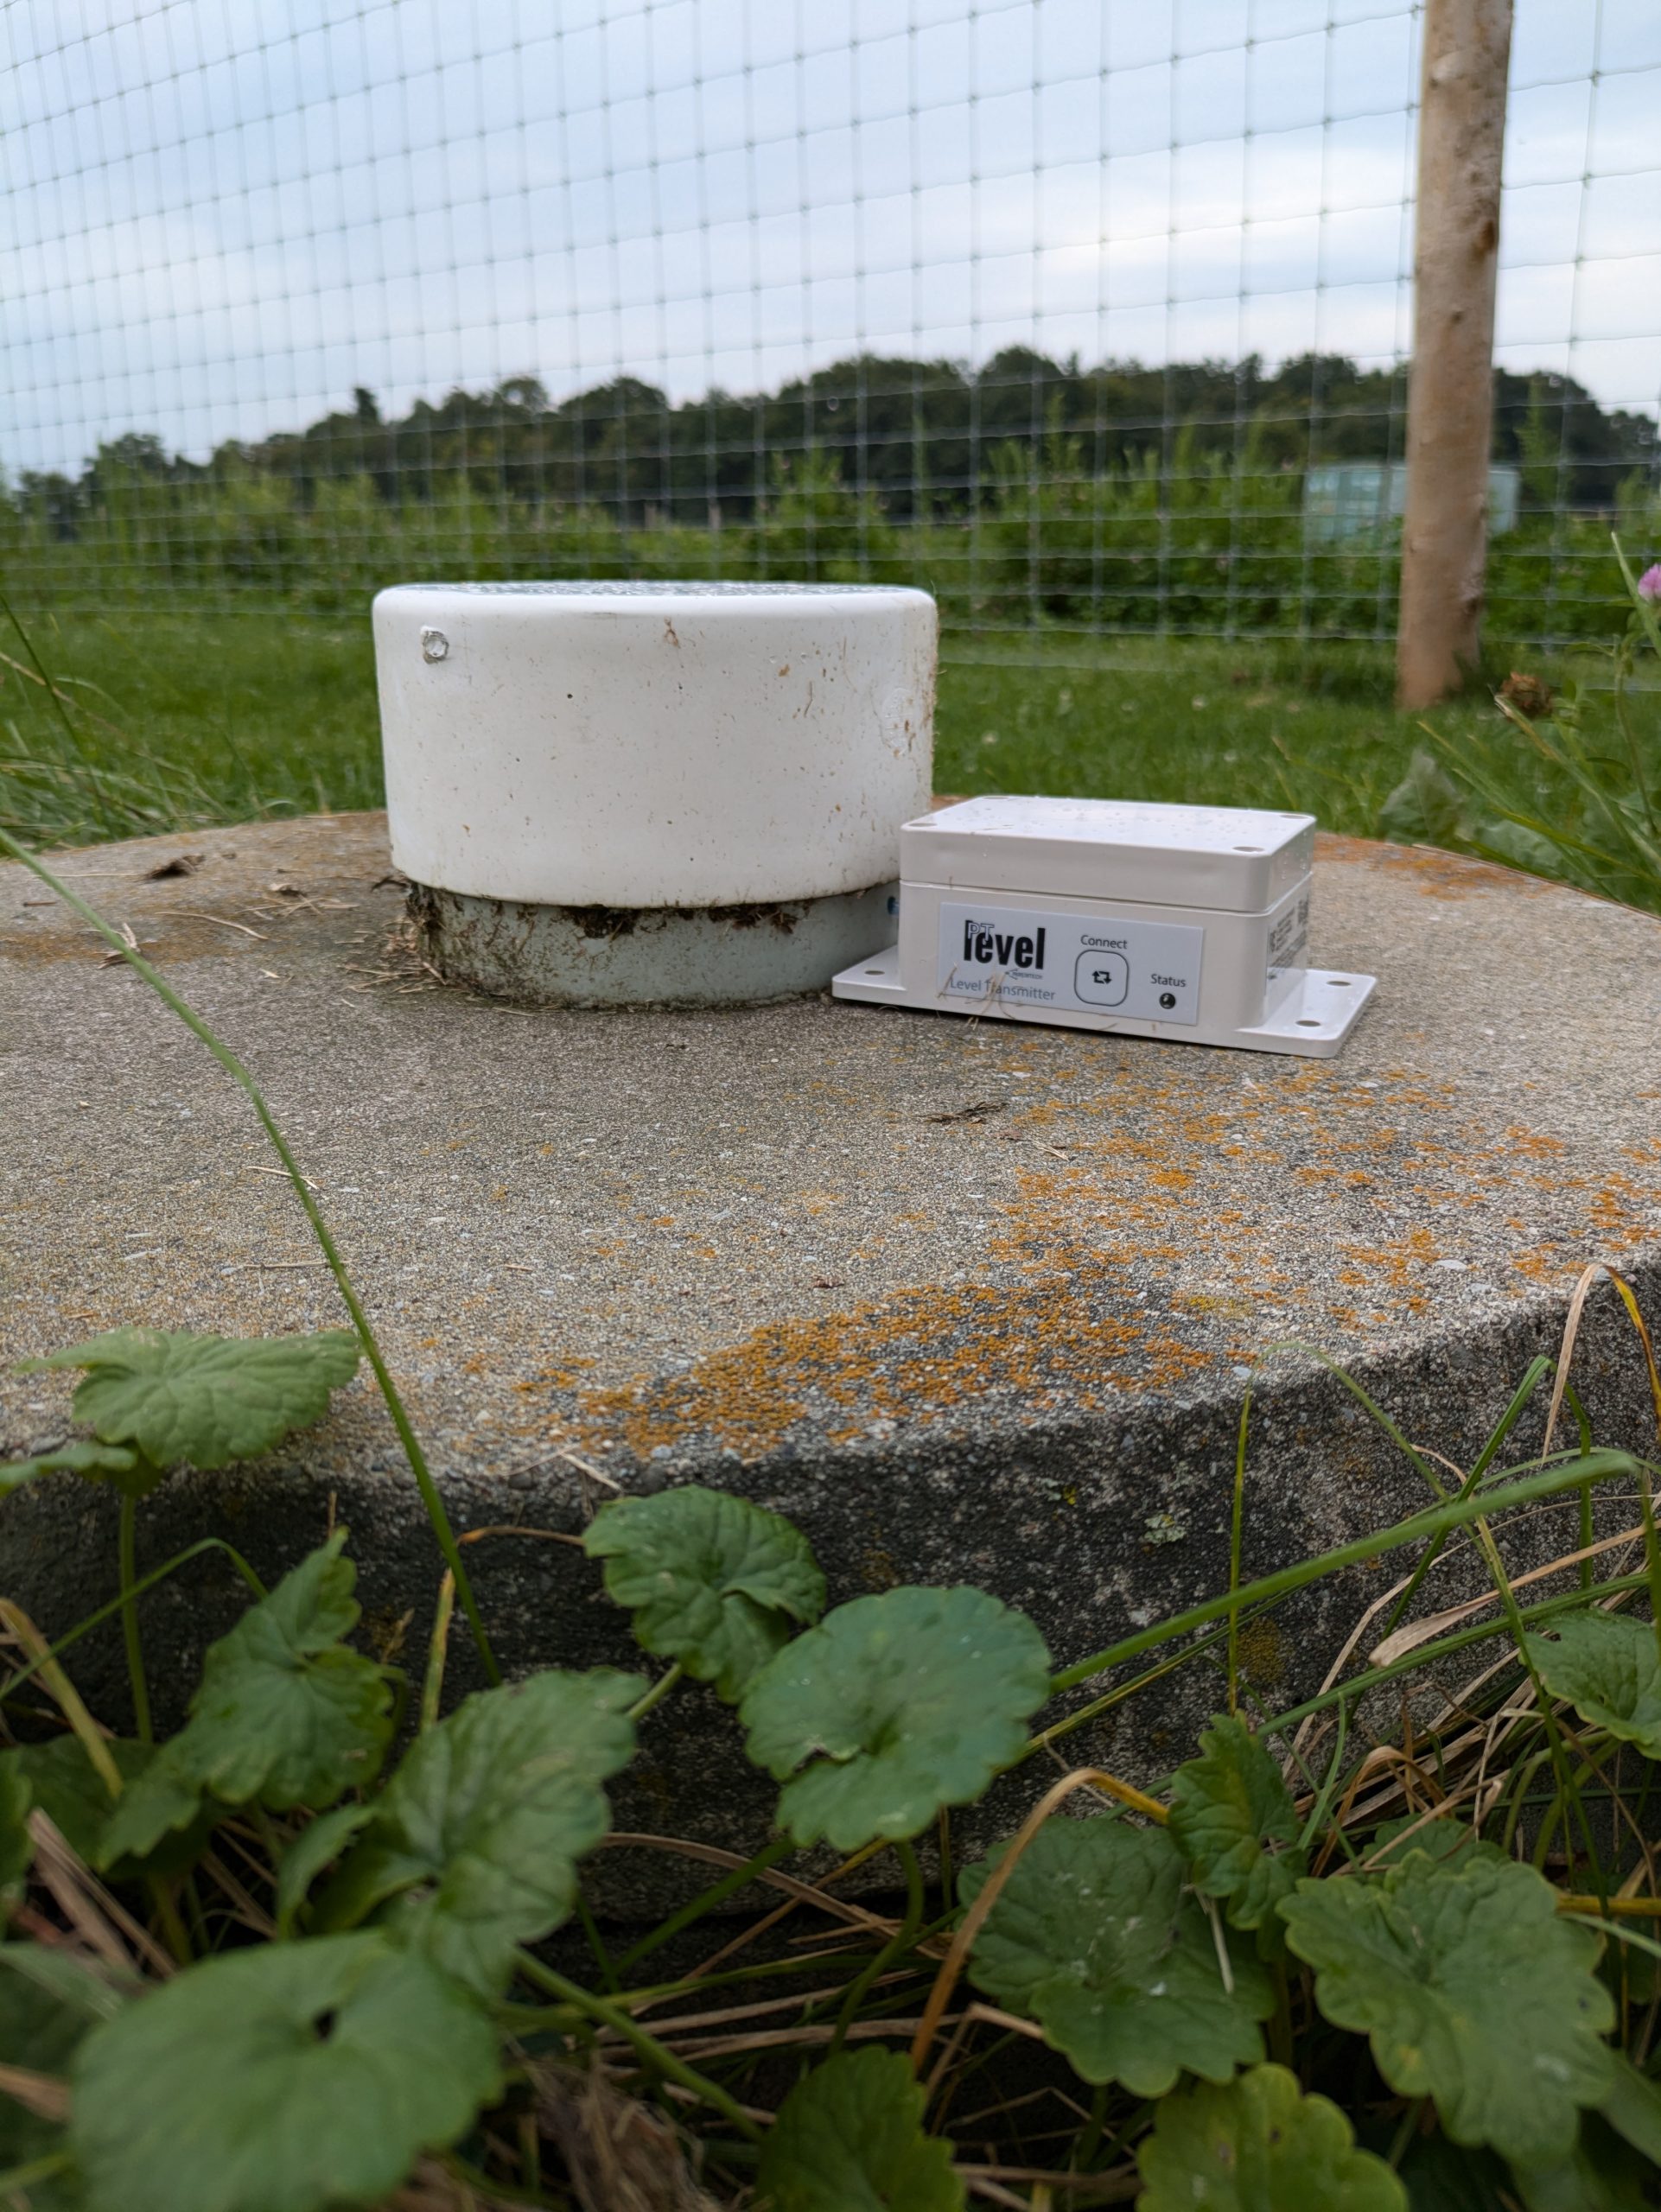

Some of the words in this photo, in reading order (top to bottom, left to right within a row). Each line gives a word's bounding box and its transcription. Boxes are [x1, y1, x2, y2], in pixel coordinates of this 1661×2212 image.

[968, 922, 995, 942] PT
[964, 919, 1046, 969] level
[1080, 934, 1128, 950] Connect
[950, 979, 982, 991] Level
[1150, 973, 1187, 988] Status
